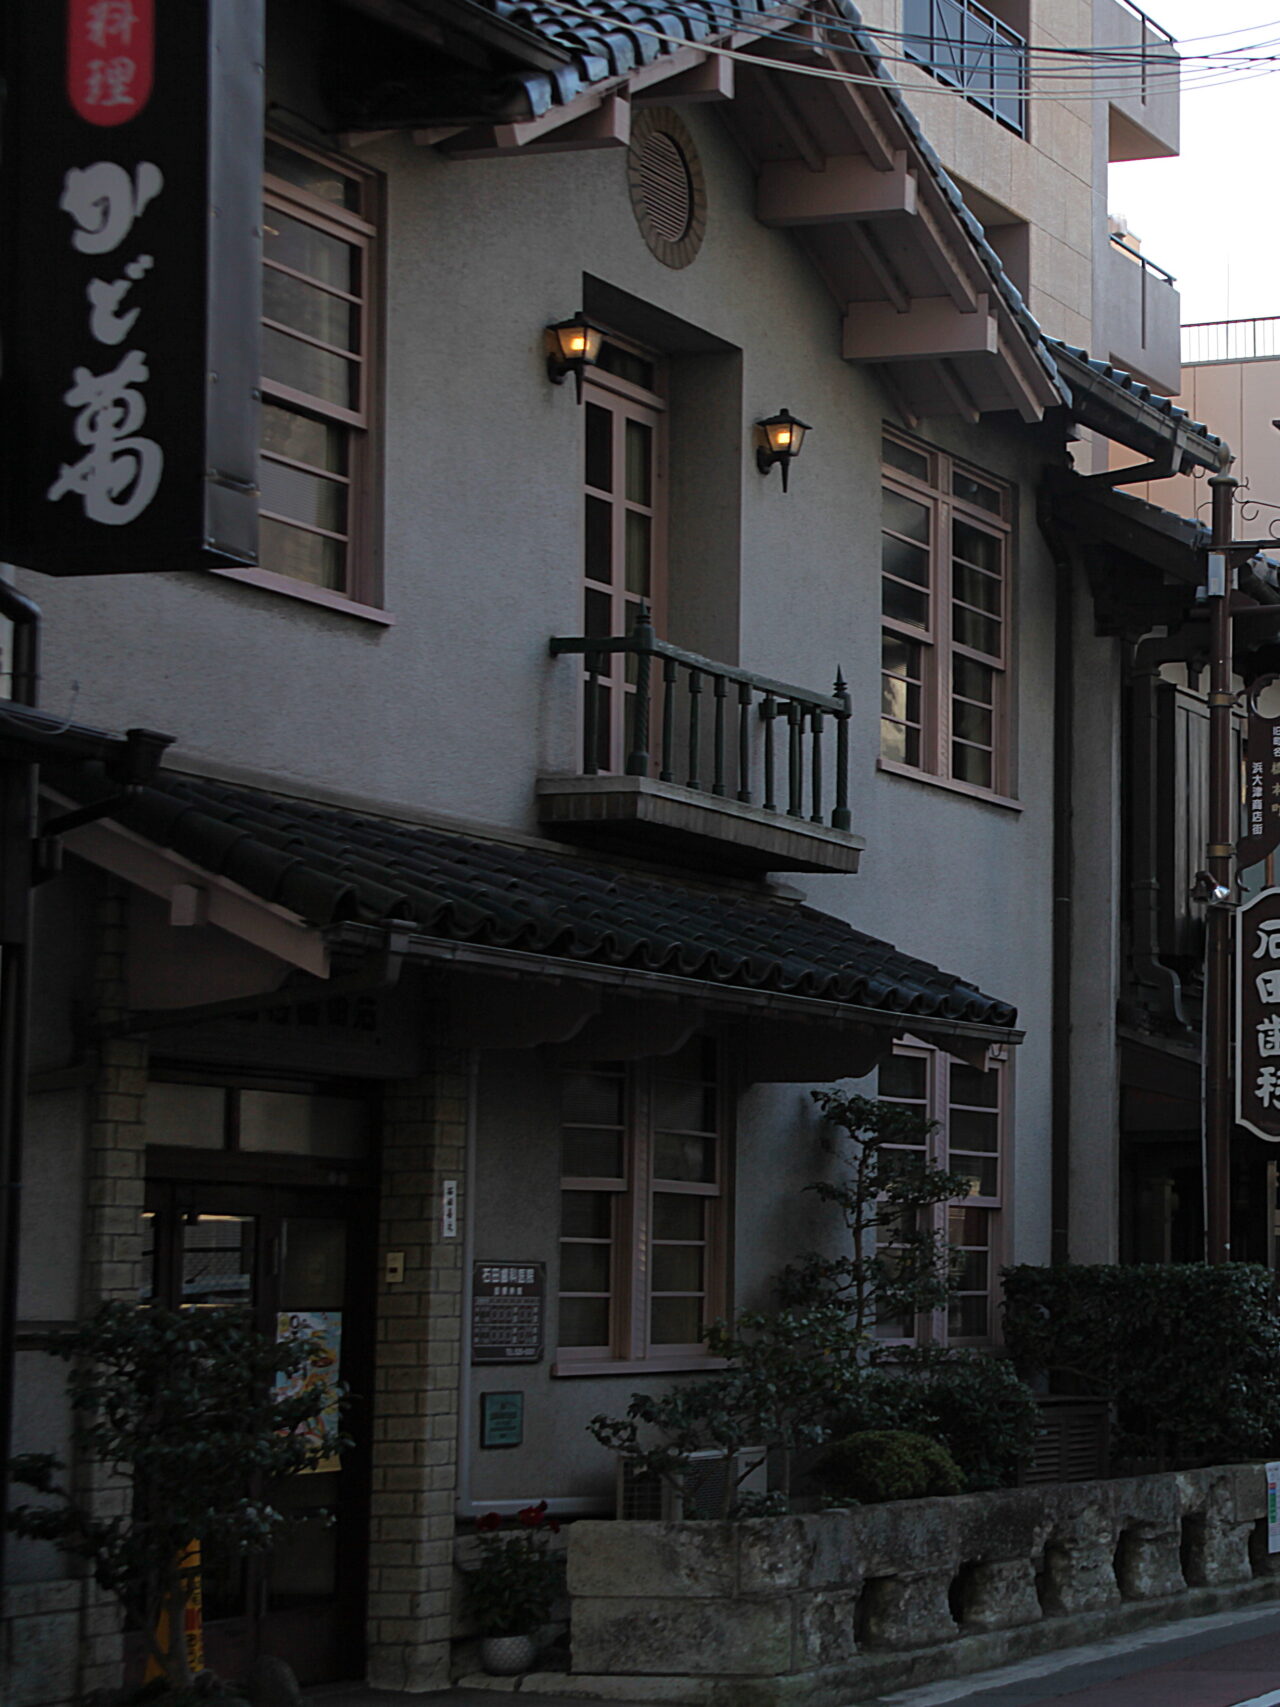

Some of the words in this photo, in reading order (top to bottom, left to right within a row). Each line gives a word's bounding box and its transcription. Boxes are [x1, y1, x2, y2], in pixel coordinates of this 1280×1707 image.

[84, 0, 139, 105] 料理
[1252, 762, 1263, 835] 浜大津商店街
